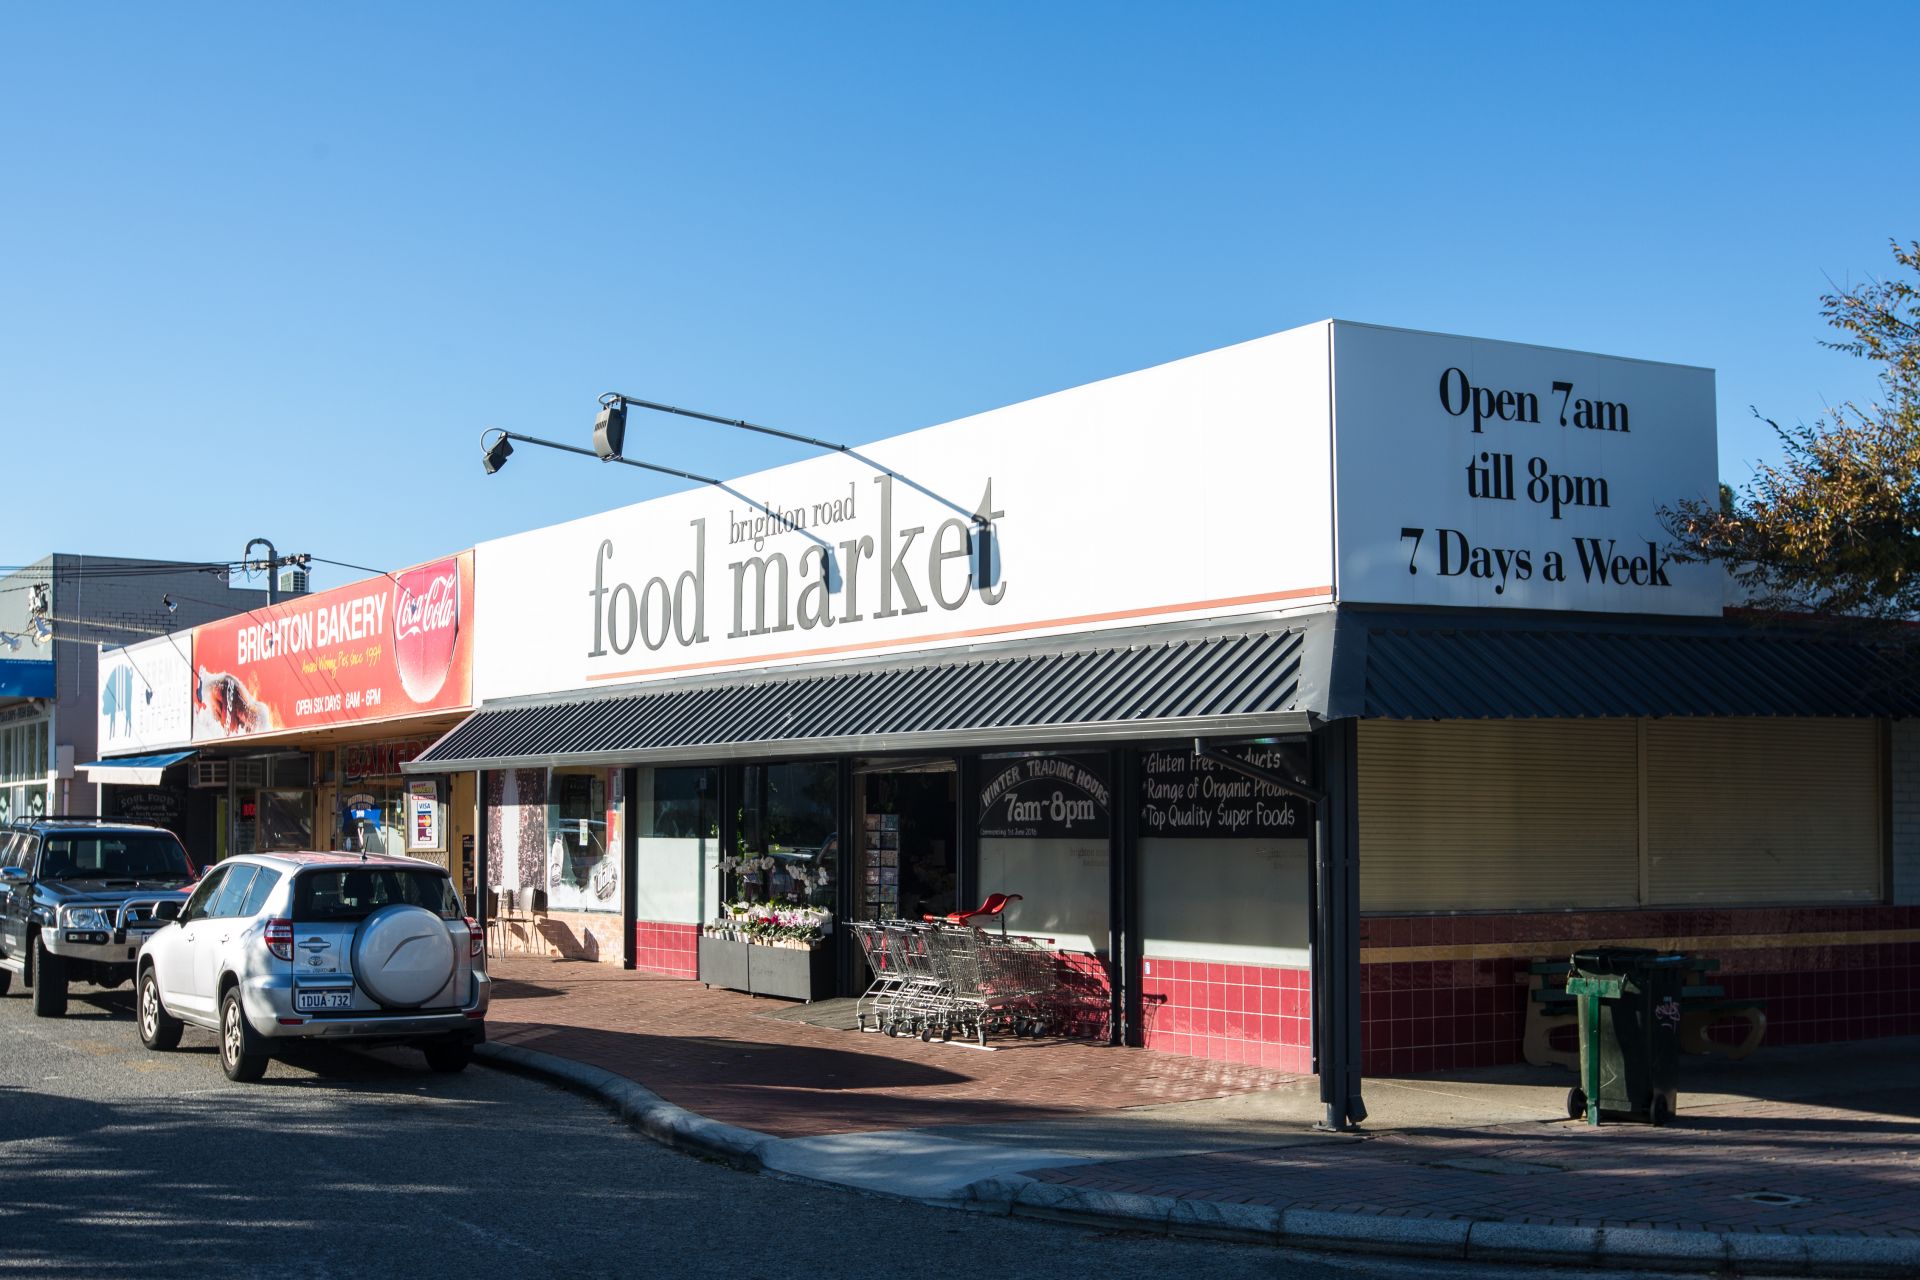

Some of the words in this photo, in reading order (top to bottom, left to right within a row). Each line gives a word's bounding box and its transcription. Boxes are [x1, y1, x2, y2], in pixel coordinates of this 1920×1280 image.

[1439, 367, 1541, 433] Open
[1551, 381, 1631, 433] 7am
[728, 500, 807, 552] brighton
[811, 481, 857, 526] road
[1465, 452, 1516, 500] till
[1527, 456, 1610, 520] 8pm
[587, 516, 710, 658] food
[727, 472, 1007, 640] market
[1400, 527, 1425, 575] 7
[1435, 528, 1532, 594] Days
[1542, 551, 1566, 582] a
[1572, 537, 1672, 587] Week
[238, 611, 312, 664] BRIGHTON
[317, 591, 388, 647] BAKERY
[295, 698, 313, 716] OPEN
[313, 696, 325, 714] SIX
[324, 693, 342, 712] DAYS
[345, 690, 360, 709] 6AM
[365, 687, 381, 707] 6PM
[981, 766, 1021, 807] WINTER
[1027, 759, 1075, 781] TRADING
[1076, 769, 1110, 807] HOURS
[1147, 752, 1185, 774] Gluten
[1190, 752, 1214, 771] Free
[1147, 777, 1184, 803] Range
[1187, 777, 1200, 799] of
[1203, 775, 1251, 803] Organic
[1147, 804, 1166, 831] Top
[1168, 804, 1213, 829] Quality
[1217, 803, 1253, 831] Super
[1256, 801, 1295, 827] Foods
